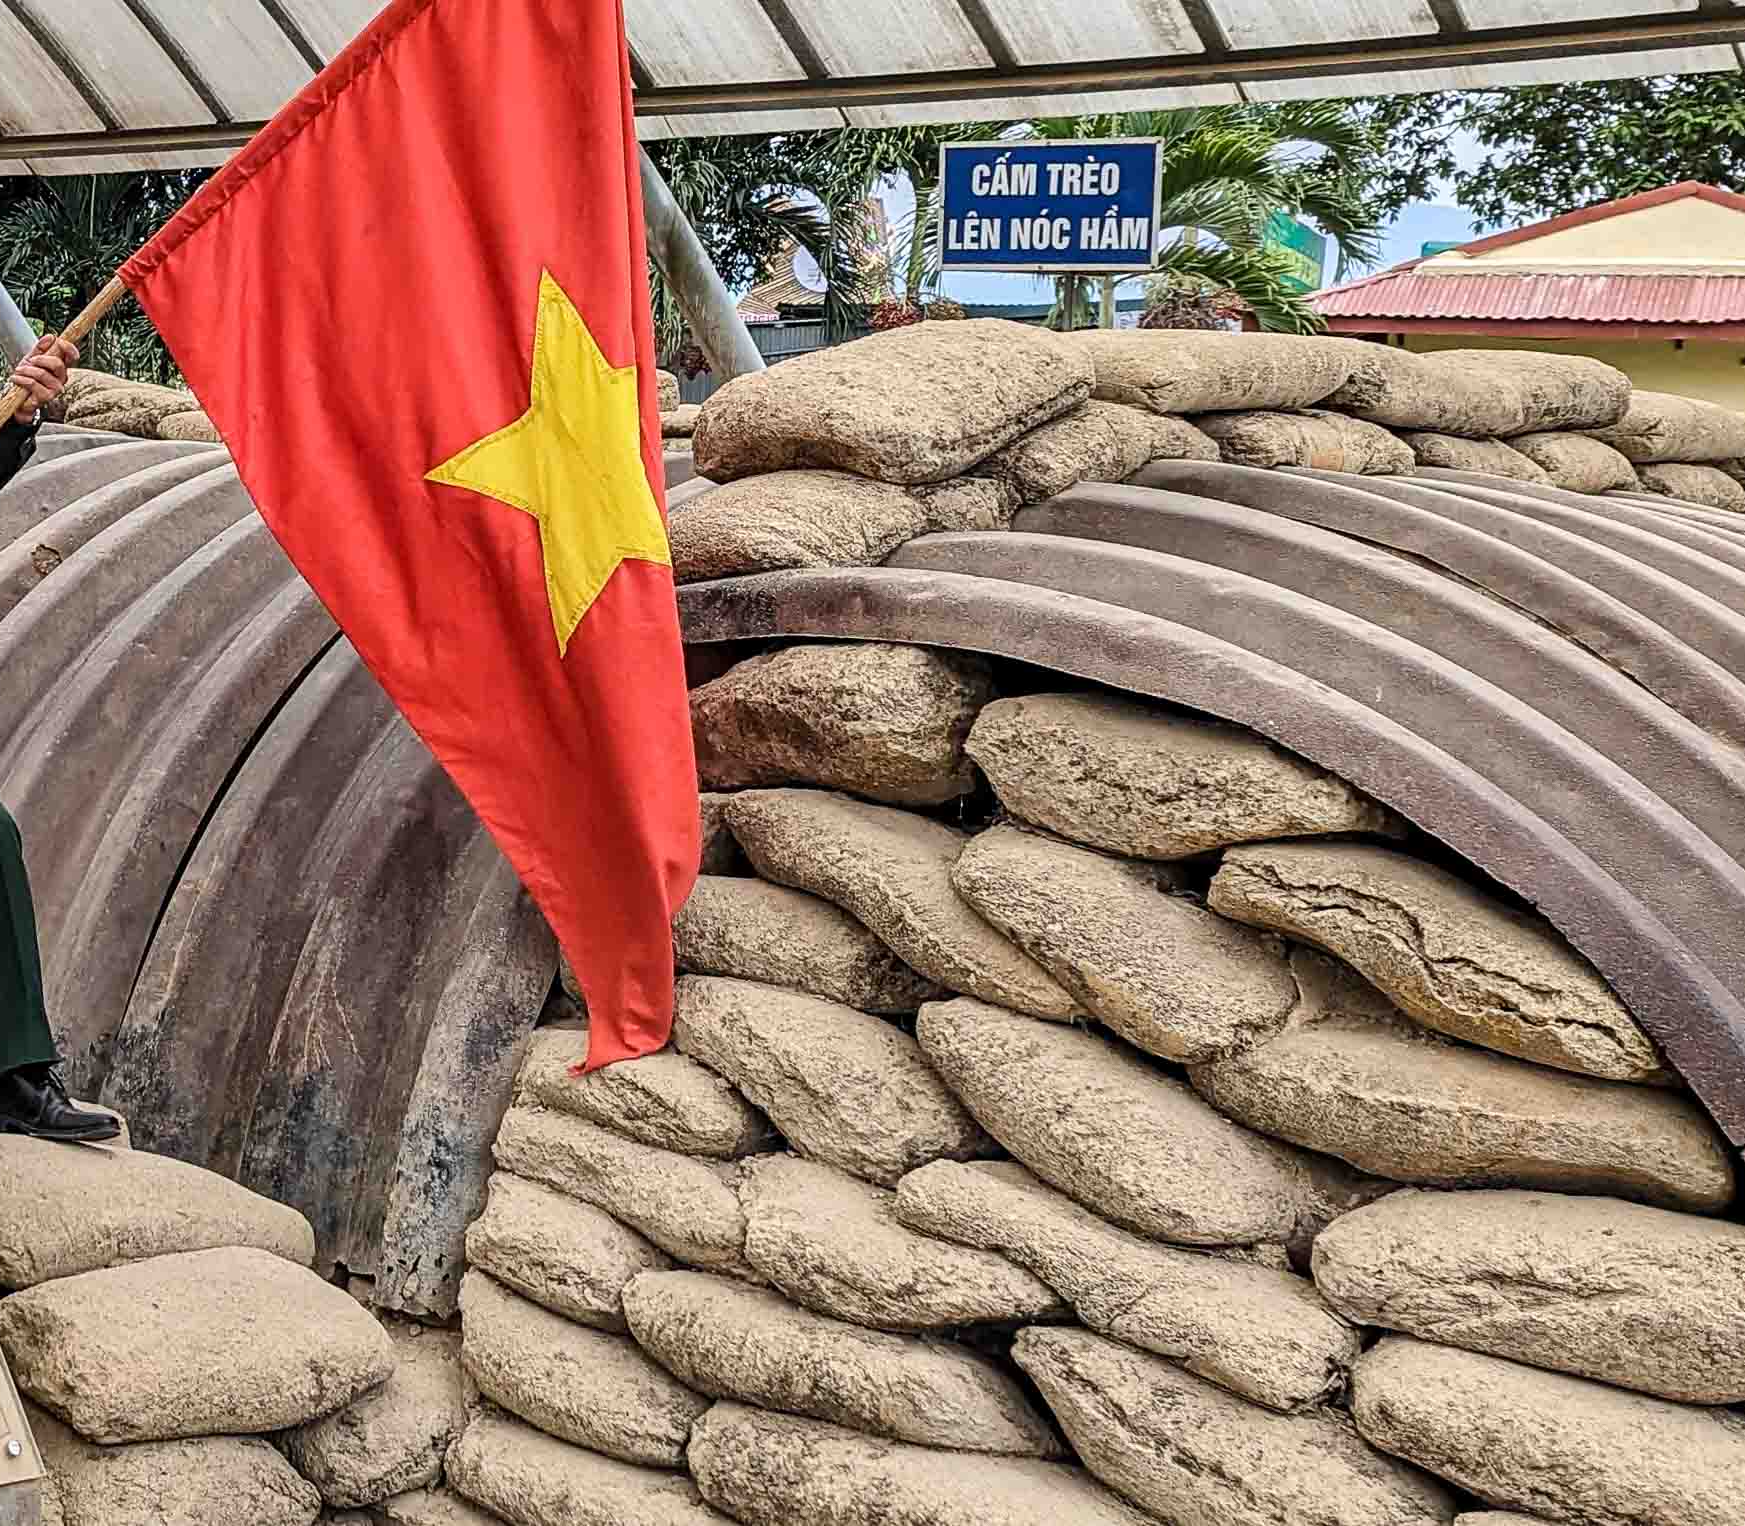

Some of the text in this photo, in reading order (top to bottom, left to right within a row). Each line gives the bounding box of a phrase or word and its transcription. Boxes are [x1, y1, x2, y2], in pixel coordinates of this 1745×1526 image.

[971, 151, 1120, 196] CẤM TRÈO
[948, 204, 1150, 250] LÊN NÓC HẦM
